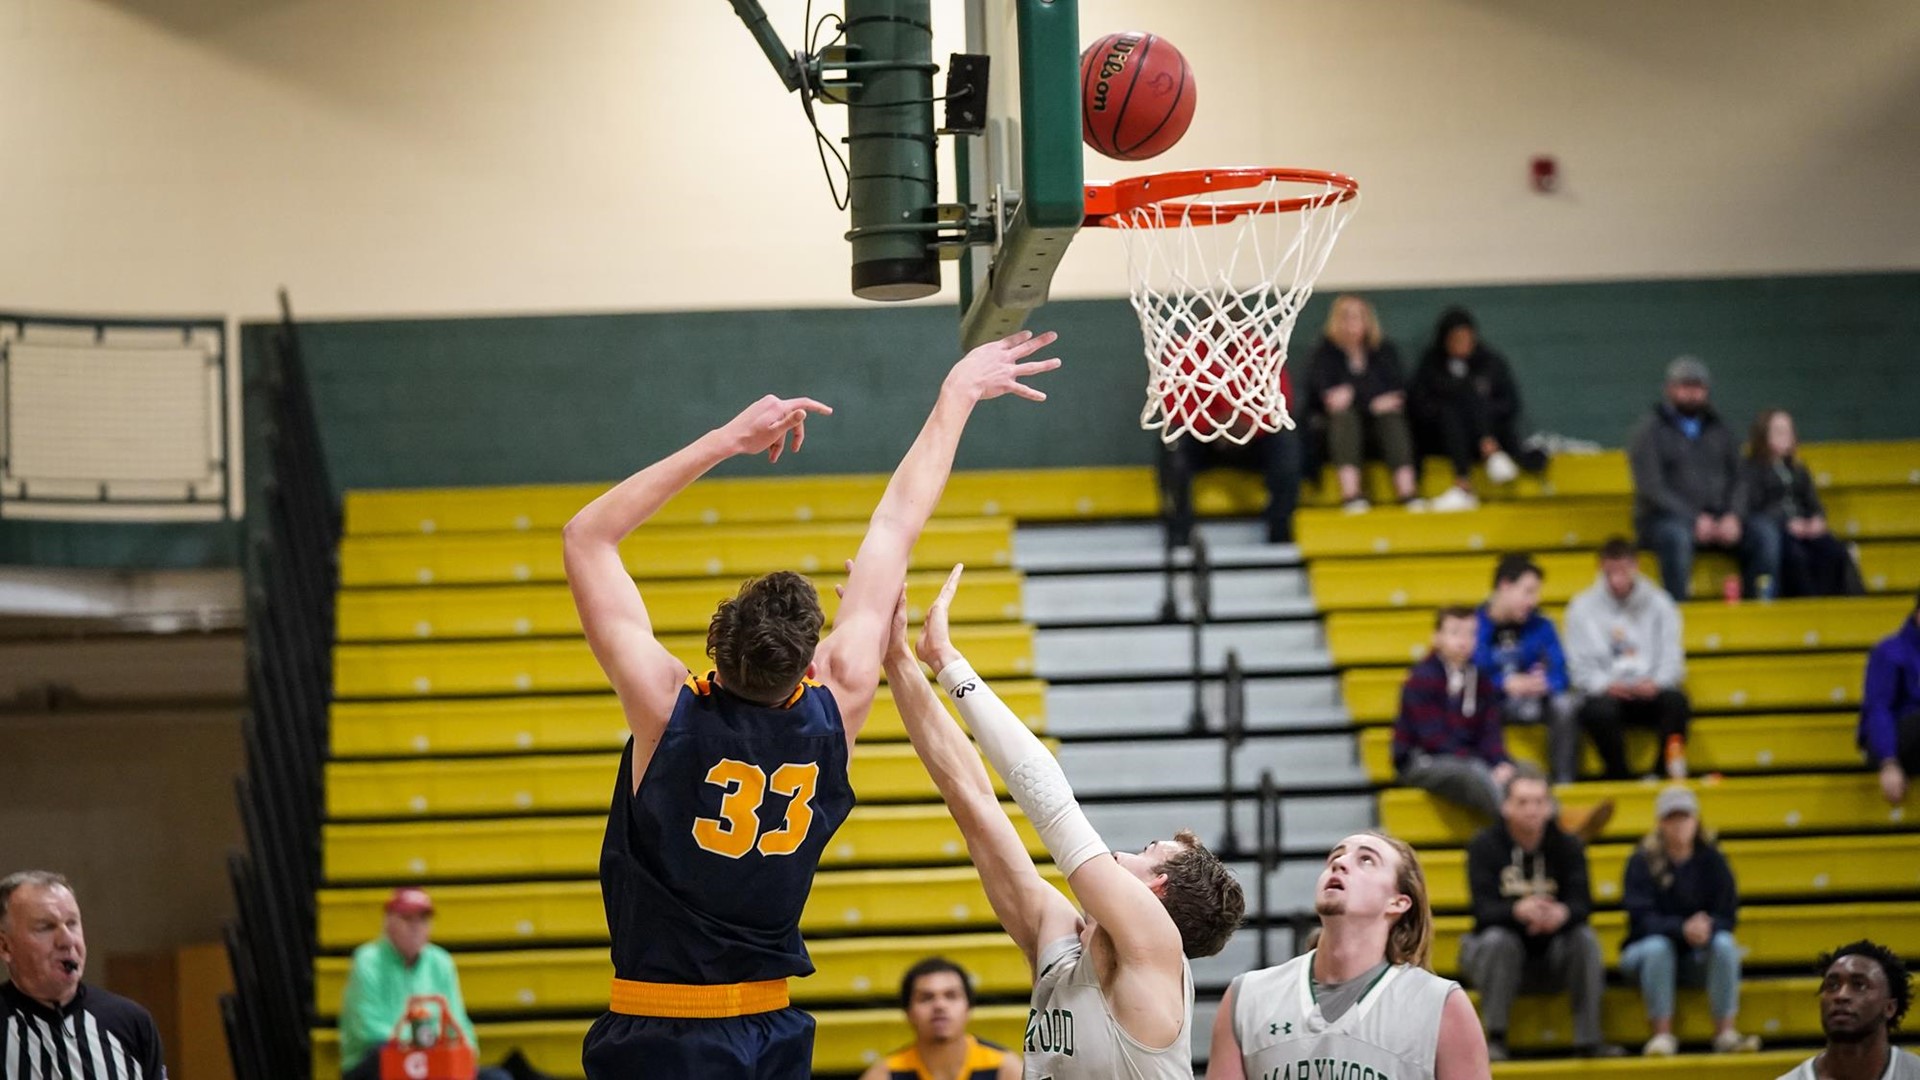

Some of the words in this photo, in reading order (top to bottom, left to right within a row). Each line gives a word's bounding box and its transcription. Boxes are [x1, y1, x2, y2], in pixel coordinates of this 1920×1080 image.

[1093, 36, 1141, 111] Wilson
[692, 758, 820, 859] 33
[1263, 1059, 1389, 1080] ARYWO
